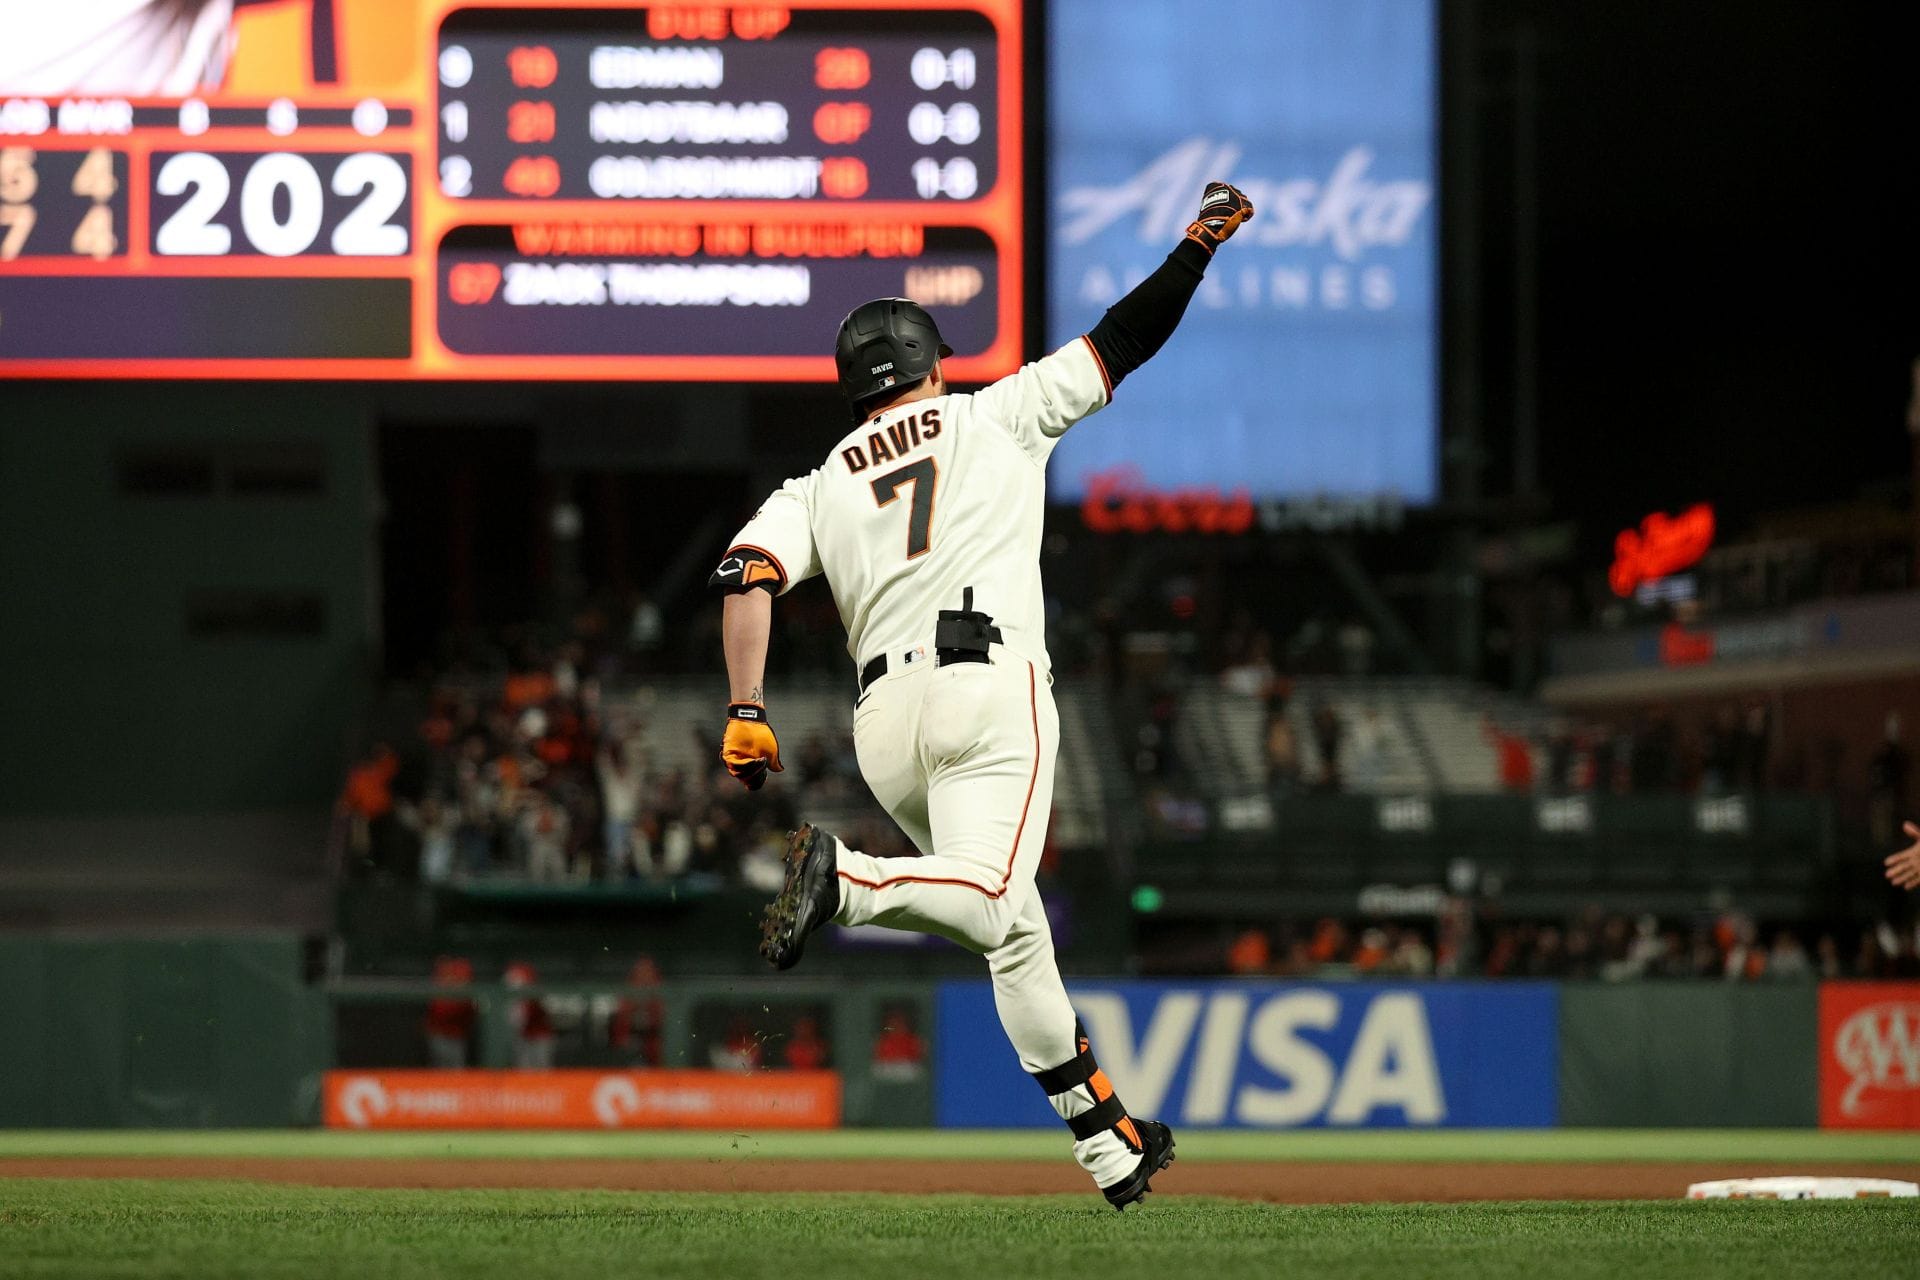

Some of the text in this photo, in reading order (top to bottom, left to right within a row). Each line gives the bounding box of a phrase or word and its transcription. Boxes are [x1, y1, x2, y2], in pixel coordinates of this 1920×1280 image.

[72, 147, 118, 204] 4
[439, 154, 473, 197] 2
[72, 204, 118, 261] 4
[702, 223, 751, 257] IN
[871, 362, 894, 375] DAVIS
[841, 408, 943, 475] DAVIS
[870, 455, 941, 561] 7
[1073, 989, 1449, 1127] VISA
